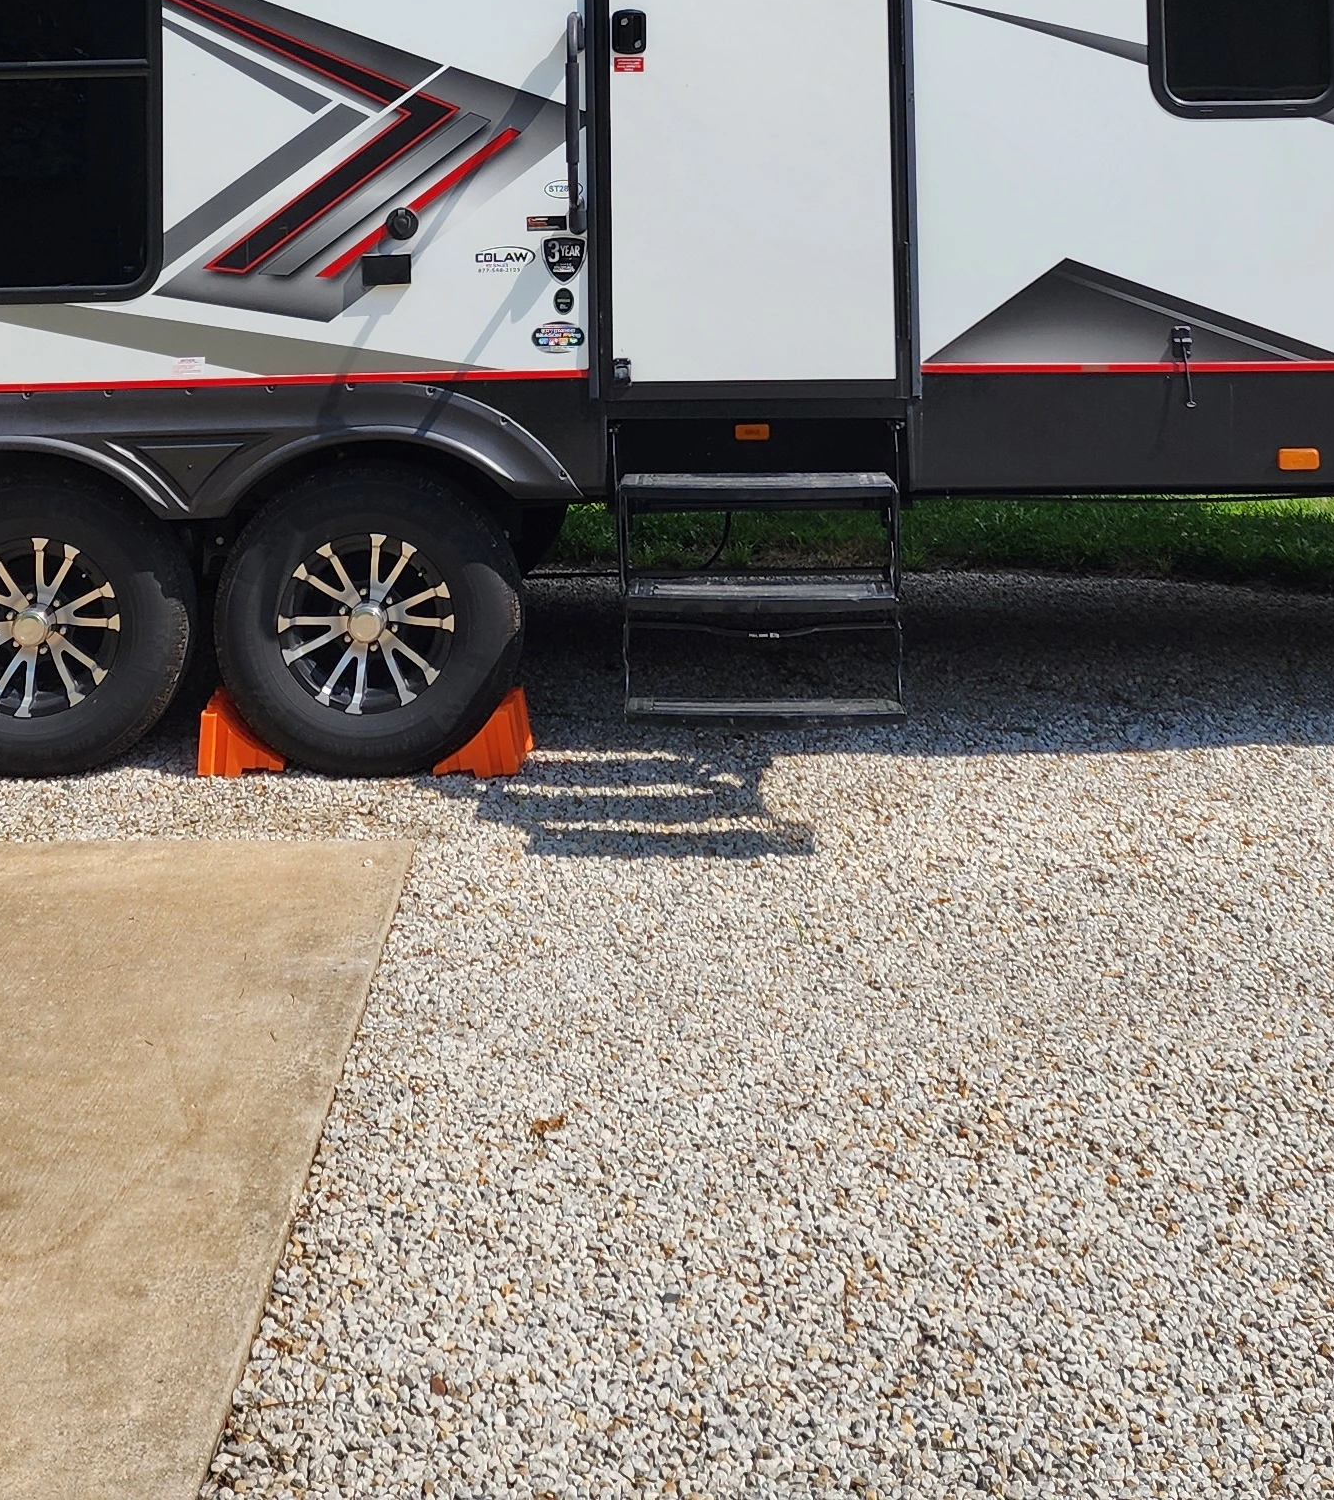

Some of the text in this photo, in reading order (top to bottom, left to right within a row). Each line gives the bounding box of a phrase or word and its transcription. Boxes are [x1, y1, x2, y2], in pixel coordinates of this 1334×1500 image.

[548, 185, 569, 193] ST28
[547, 240, 581, 263] 3 YEAR
[475, 252, 528, 263] COLAW
